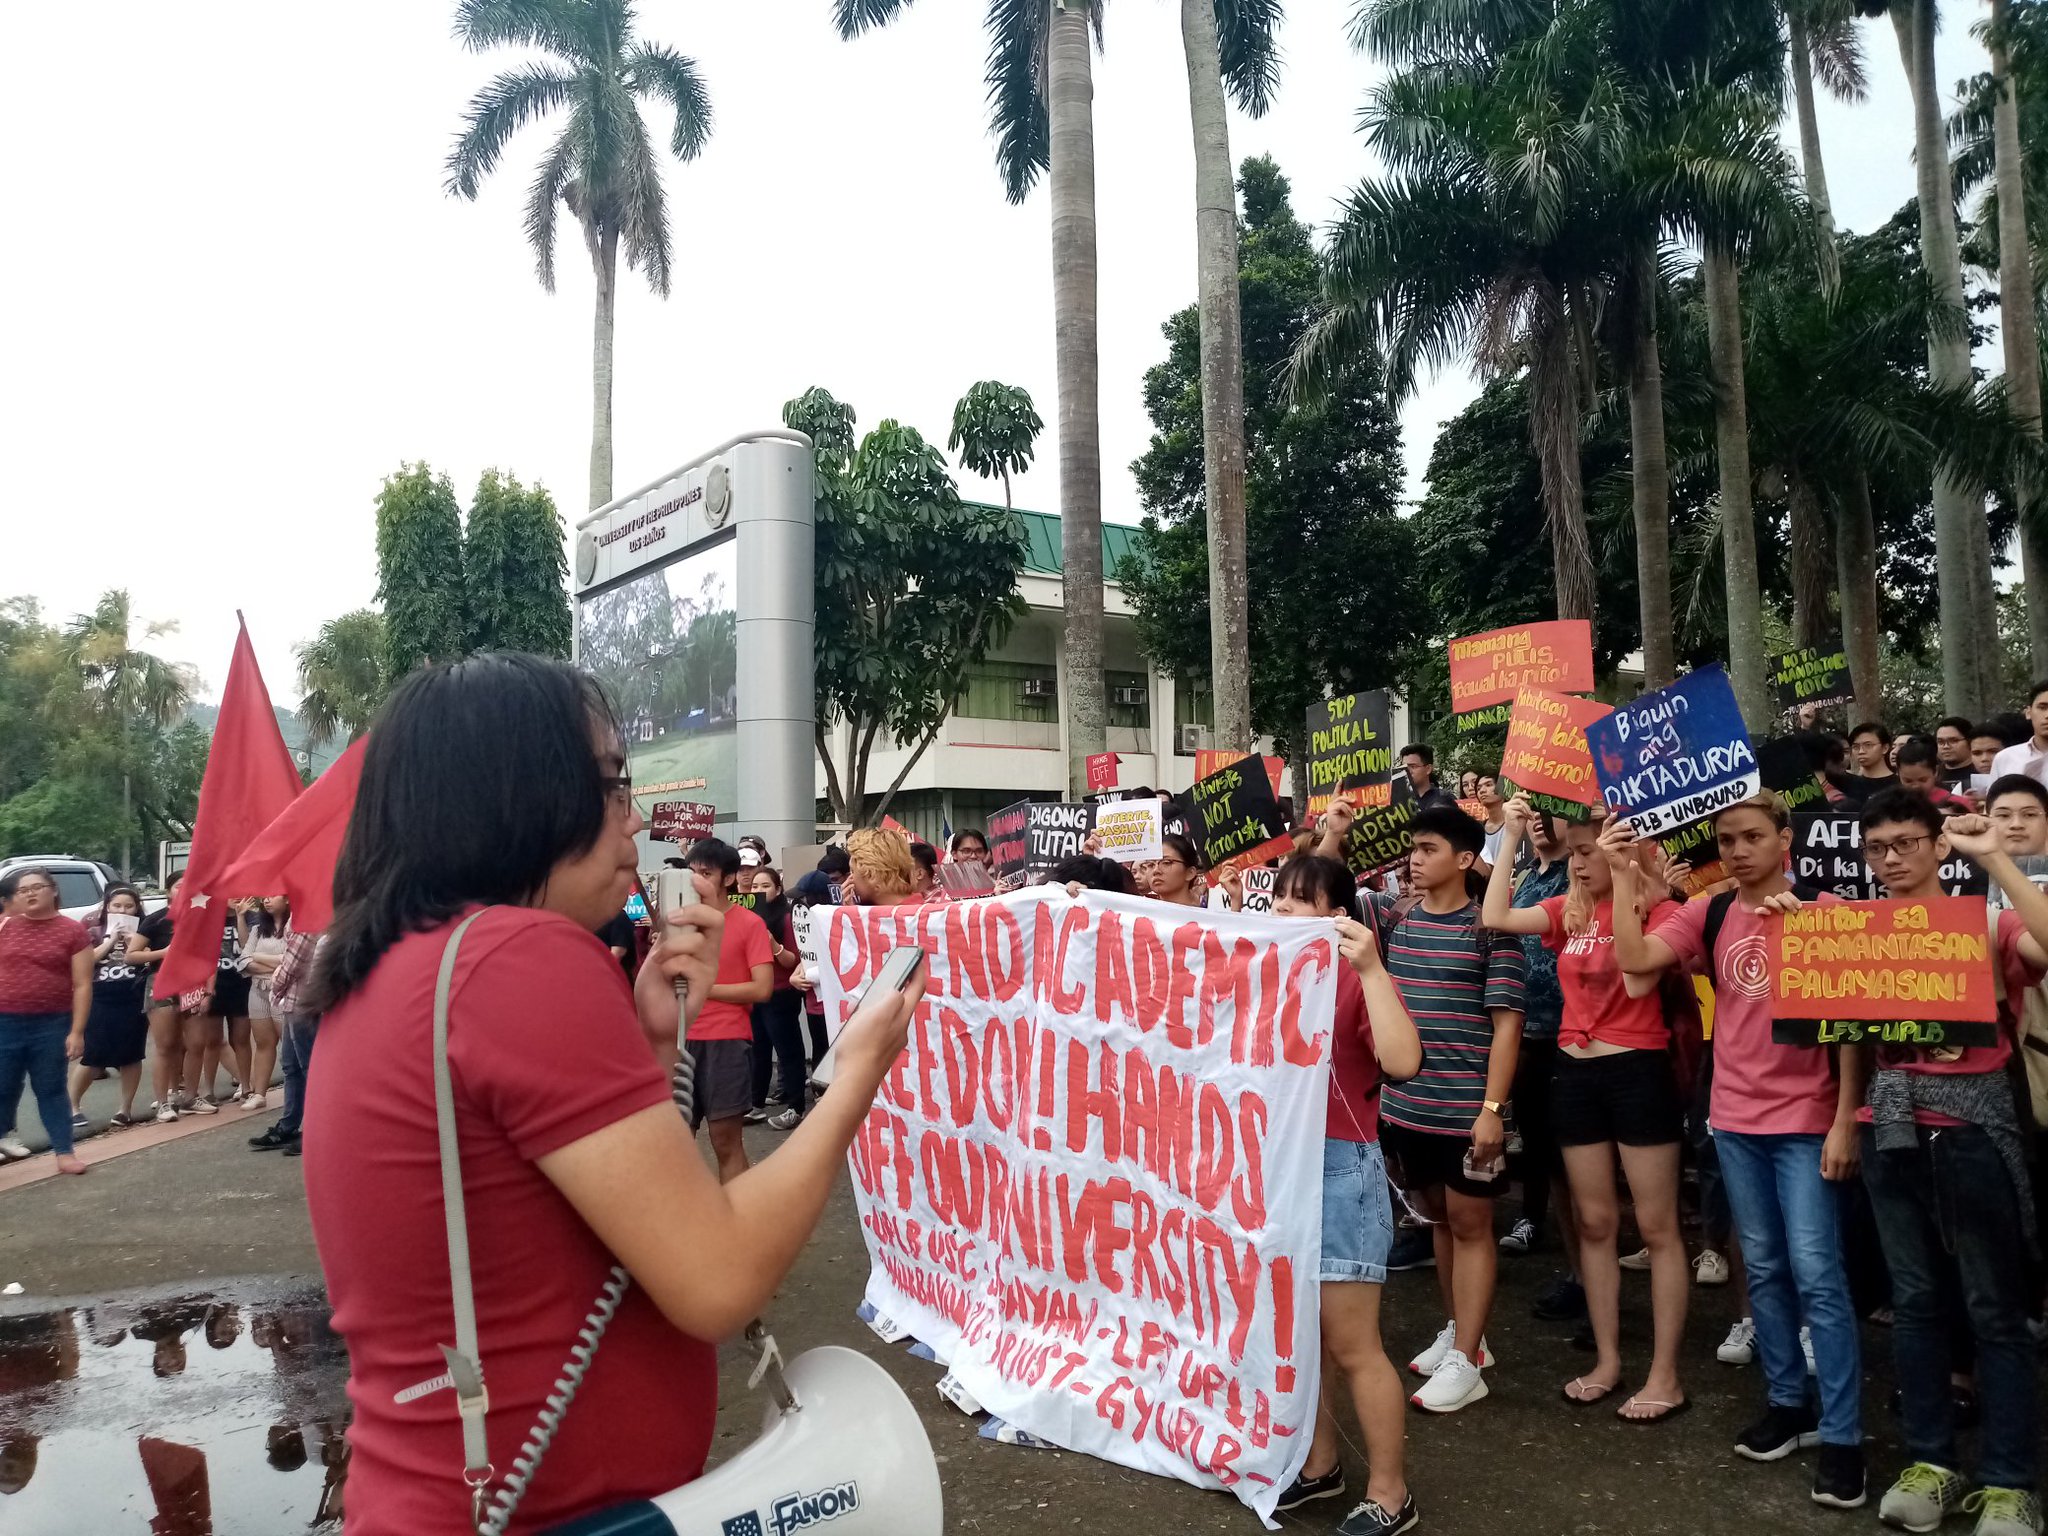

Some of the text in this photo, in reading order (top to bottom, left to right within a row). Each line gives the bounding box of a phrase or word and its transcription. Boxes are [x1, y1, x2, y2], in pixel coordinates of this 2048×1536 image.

[599, 486, 702, 547] UNIVERSITY OF THE PHILIPPINES
[629, 536, 642, 553] LOS
[1782, 646, 1817, 669] NO TO
[1794, 671, 1837, 698] ROTC
[1327, 694, 1356, 723] STOP
[1615, 690, 1689, 743] Biguin
[1311, 718, 1378, 756] POLITICAL
[1639, 721, 1682, 766] ang
[1092, 764, 1110, 782] OFF
[1311, 746, 1392, 788] PERSECUTION
[1604, 739, 1755, 810] DIKTADURYA
[656, 802, 714, 816] EQUAL PAY
[1361, 783, 1389, 805] UPLB
[653, 819, 714, 833] EQUAL WORK
[674, 811, 693, 821] FOR
[1028, 806, 1088, 830] DIGONG
[1202, 791, 1234, 834] NOT
[1031, 828, 1086, 859] TUTA!
[1097, 821, 1147, 837] SASHAY
[1104, 832, 1143, 849] AWAY
[1833, 856, 1860, 878] ka
[1832, 883, 1859, 899] sa
[1783, 903, 1930, 934] Militar sa
[1780, 931, 1989, 964] PAMANTASAN
[99, 965, 137, 981] SOC
[828, 900, 1333, 1068] DEFEND ACADEMIC
[1779, 966, 1968, 1003] PALAYASIN!
[1064, 1037, 1269, 1233] HANDS
[927, 1228, 978, 1284] USC
[768, 1484, 858, 1536] FANON
